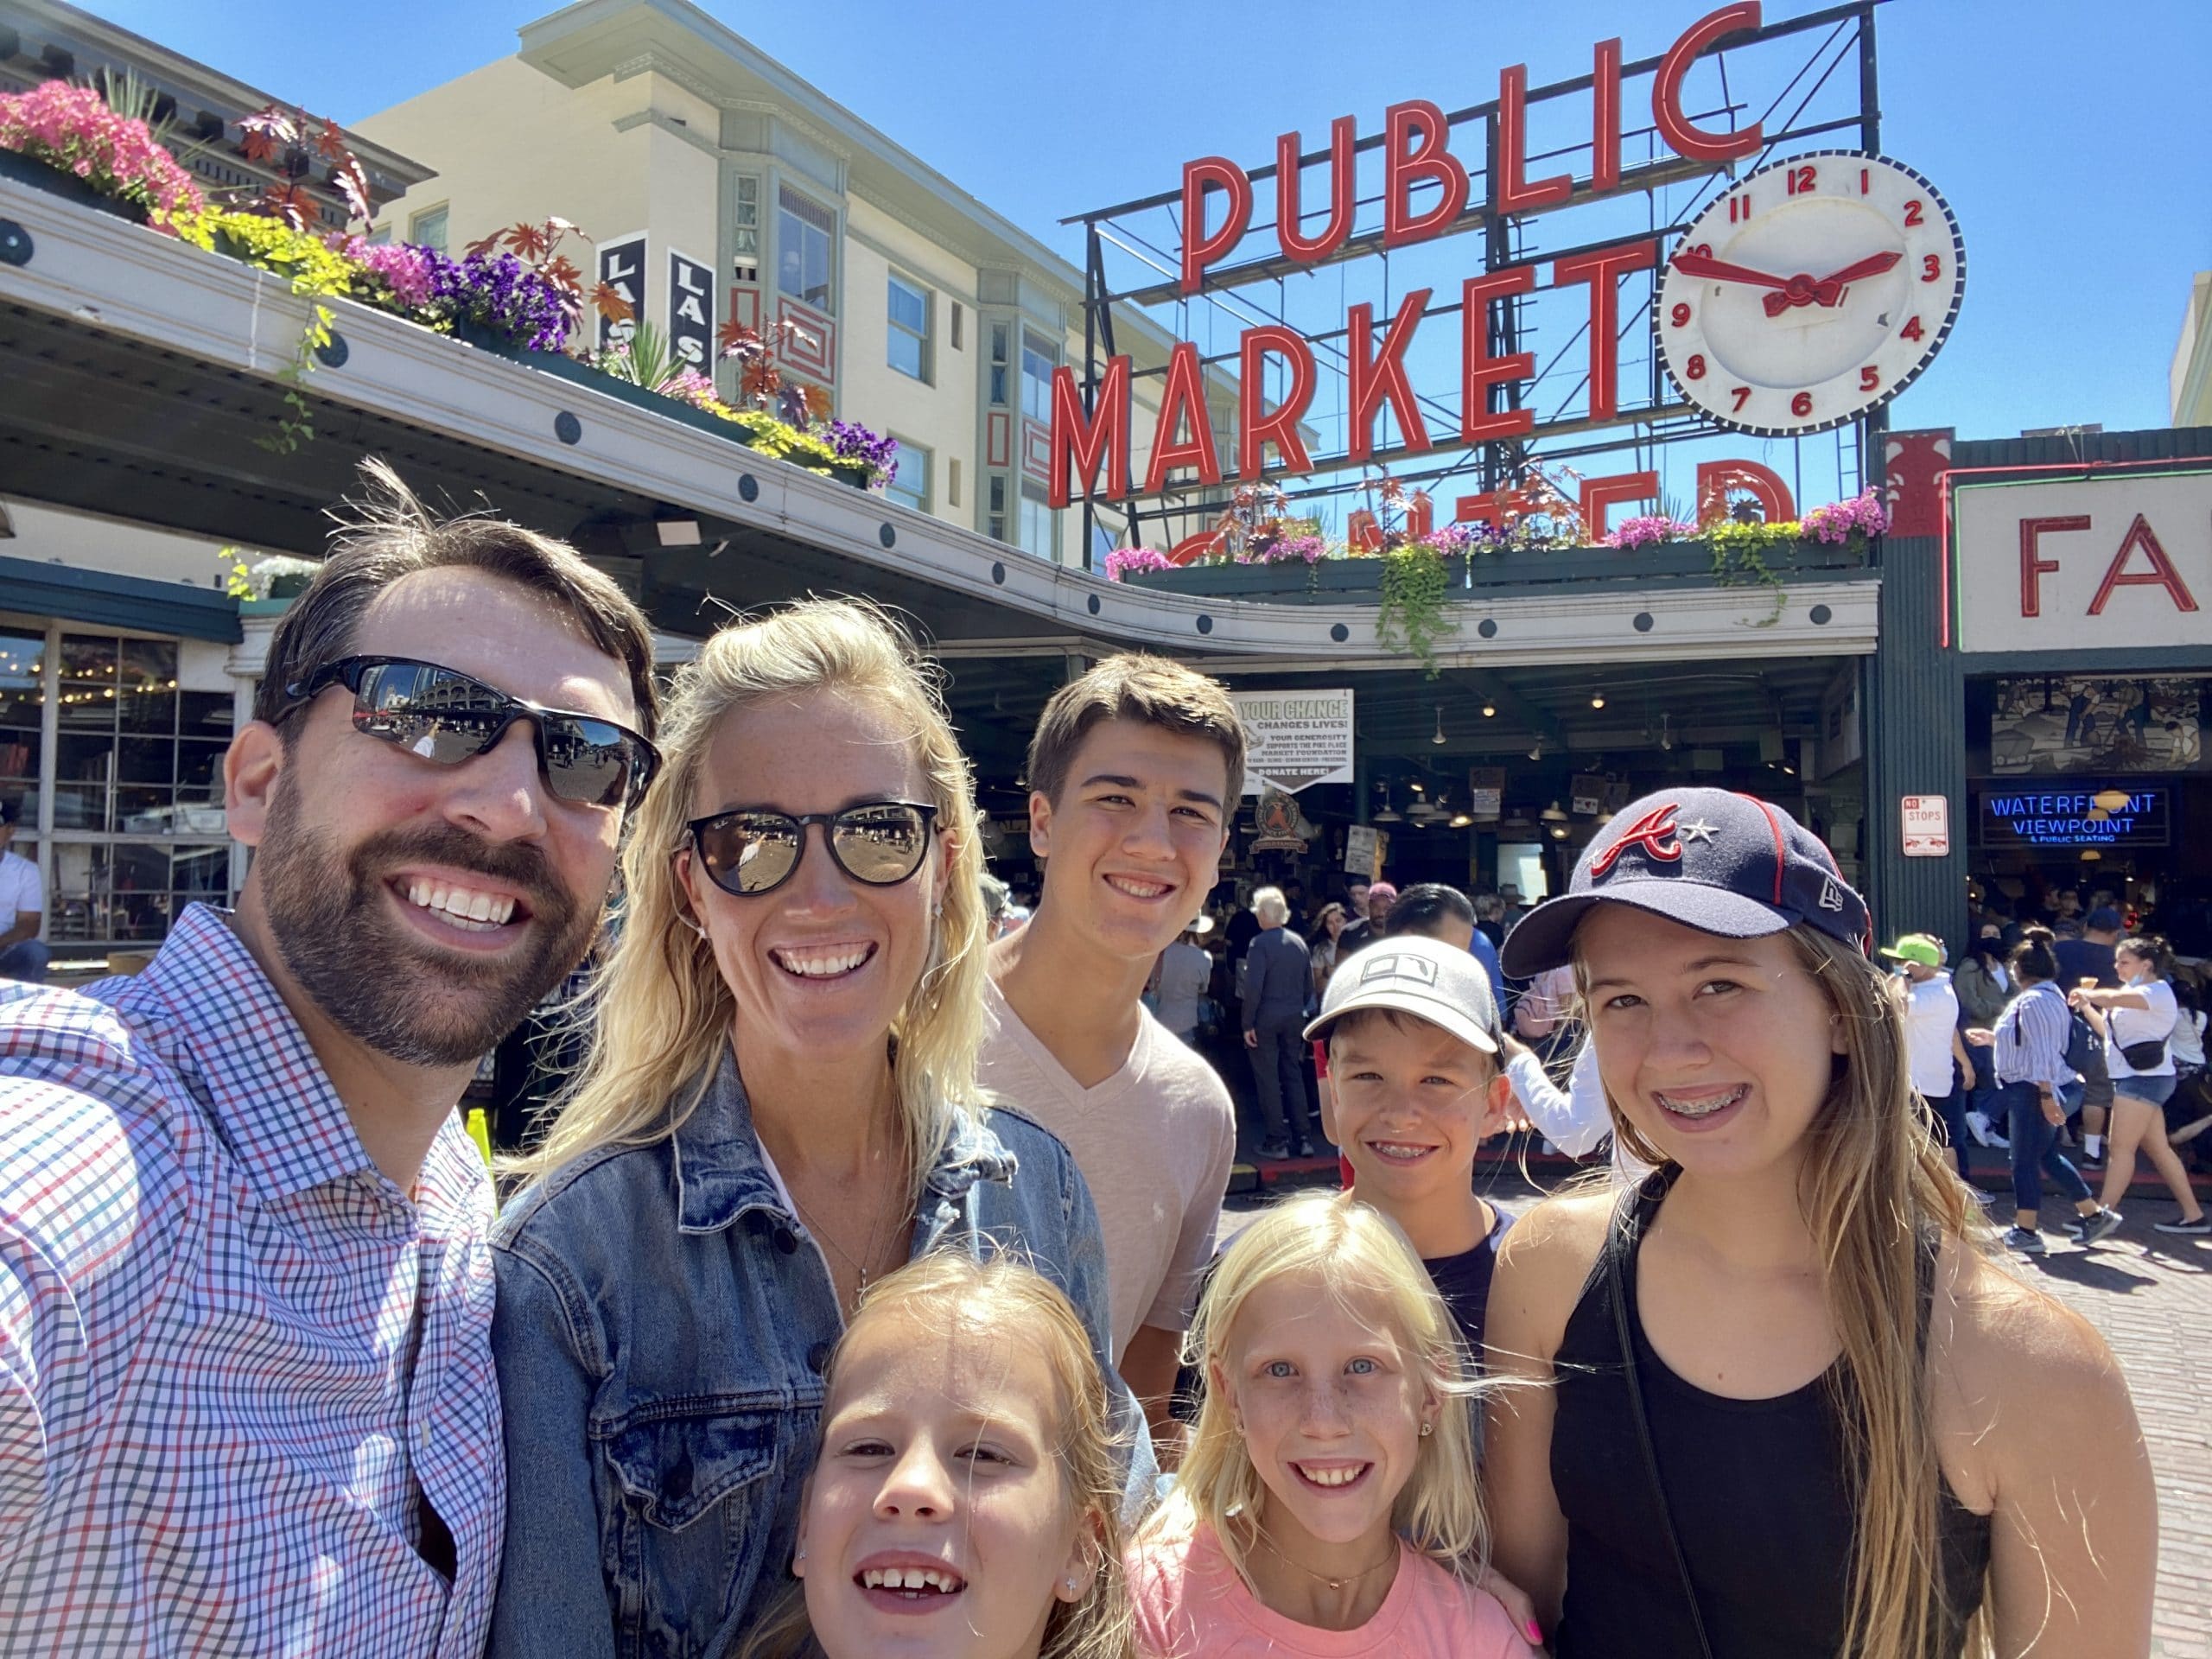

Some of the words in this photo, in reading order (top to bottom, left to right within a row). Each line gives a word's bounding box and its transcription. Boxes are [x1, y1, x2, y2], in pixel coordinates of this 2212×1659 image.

[1180, 0, 1762, 294] PUBLIC
[1787, 165, 1817, 196] 12
[1860, 168, 1869, 194] 1
[1729, 194, 1751, 223] 11
[1904, 200, 1924, 227] 2
[1920, 254, 1942, 283] 3
[1671, 302, 1691, 327] 9
[1899, 315, 1925, 342] 4
[1048, 238, 1657, 509] MARKET
[1687, 354, 1706, 380] 8
[1859, 365, 1879, 391] 5
[1732, 386, 1751, 413] 7
[1791, 392, 1813, 417] 6
[2020, 508, 2212, 617] FA
[1240, 701, 1282, 721] YOUR
[1284, 700, 1348, 720] CHANGE
[1257, 721, 1310, 729] CHANGES
[1313, 720, 1348, 728] LIVES!
[1905, 799, 1918, 808] NO
[1909, 811, 1942, 821] STOPS
[1991, 794, 2156, 817] WATERFNT
[2012, 818, 2135, 835] VIEWPOINT
